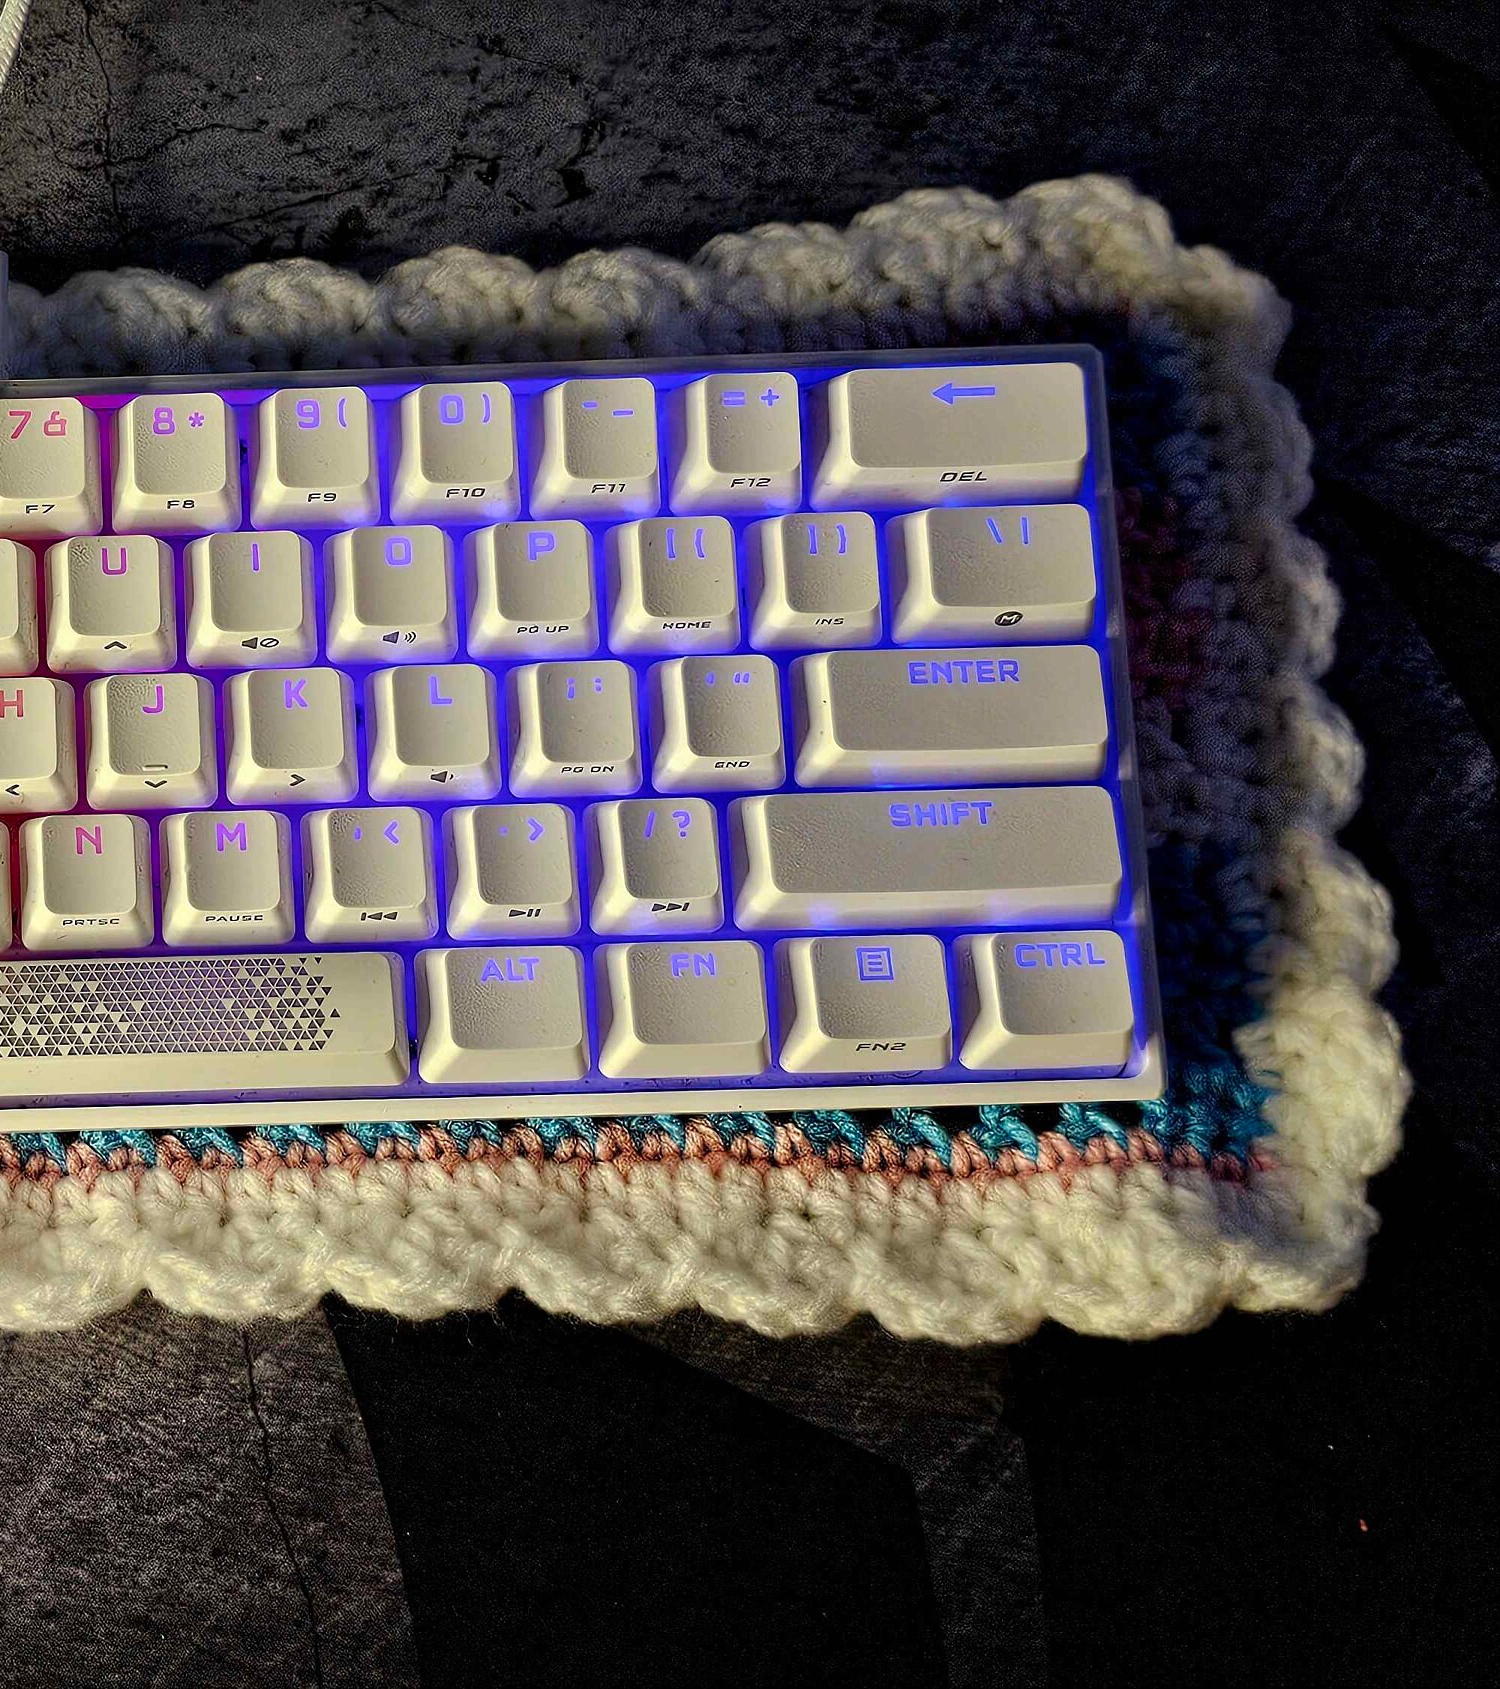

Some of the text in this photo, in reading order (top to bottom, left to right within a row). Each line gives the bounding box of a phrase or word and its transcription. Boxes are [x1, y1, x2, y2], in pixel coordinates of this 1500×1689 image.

[591, 483, 626, 494] F11
[730, 478, 771, 488] F12
[940, 472, 987, 482] DEL
[167, 499, 195, 509] F8
[307, 492, 336, 503] F9
[446, 488, 485, 498] F10
[25, 504, 55, 515] F7
[386, 537, 412, 566] O
[528, 532, 554, 560] P
[102, 547, 126, 575] U
[545, 625, 570, 633] UP
[662, 621, 711, 629] HOME
[908, 660, 1019, 684] ENTER
[142, 685, 164, 714] J
[284, 680, 308, 708] K
[429, 676, 452, 705] L
[890, 802, 993, 827] SHIFT
[76, 826, 102, 854] N
[217, 822, 246, 851] M
[62, 918, 120, 926] PRTSC
[205, 914, 264, 922] PAUSE
[672, 954, 715, 977] FN
[1015, 944, 1106, 968] CTRL
[481, 957, 539, 982] ALT
[856, 1042, 906, 1052] FN2
